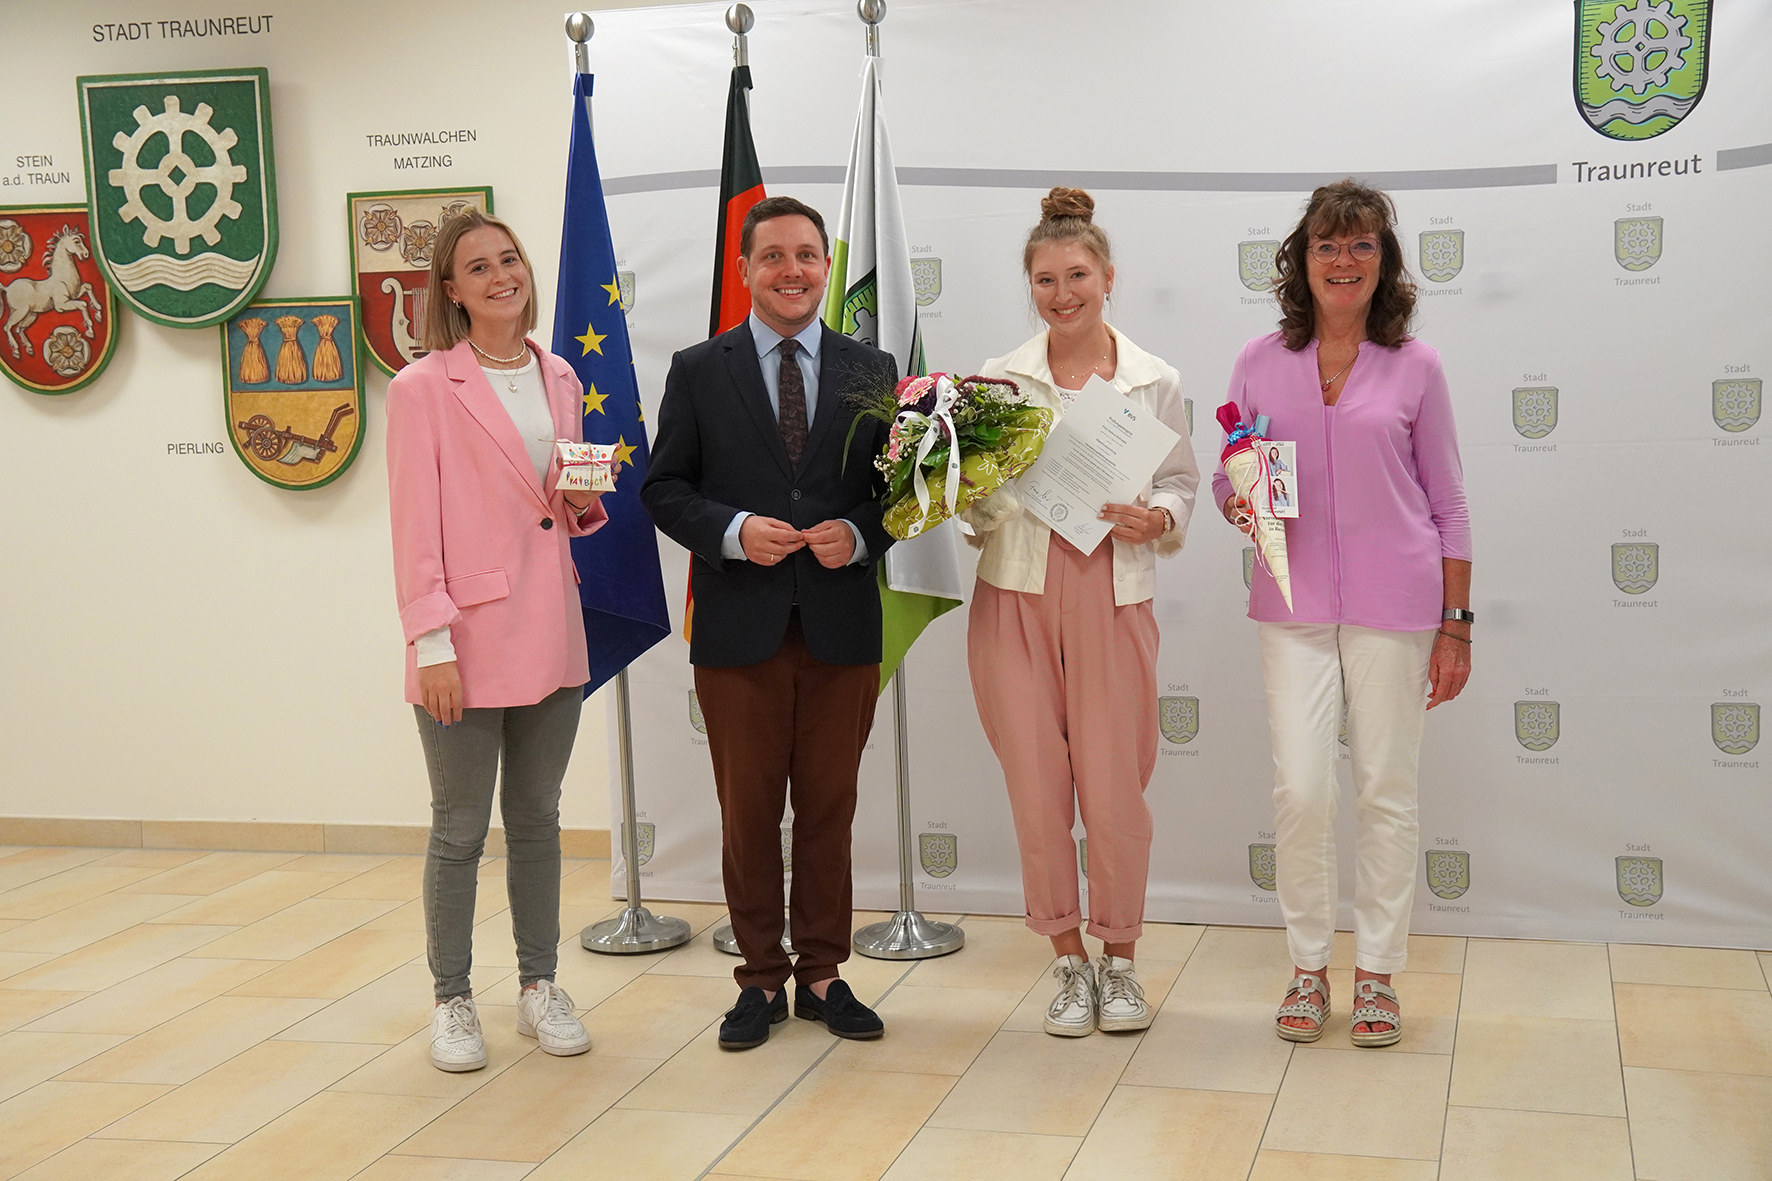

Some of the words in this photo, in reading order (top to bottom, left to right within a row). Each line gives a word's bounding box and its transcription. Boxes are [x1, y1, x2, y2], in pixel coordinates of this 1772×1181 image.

[93, 22, 152, 42] STADT
[158, 15, 273, 38] TRAUNREUT
[366, 130, 476, 147] TRAUNWALCHEN
[17, 155, 52, 168] STEIN
[394, 155, 452, 169] MATZING
[1572, 155, 1701, 182] Traunreut
[3, 174, 24, 186] a.d.
[27, 172, 69, 184] TRAUN
[1627, 202, 1651, 212] Stadt
[1430, 216, 1453, 225] Stadt
[1248, 227, 1270, 235] Stadt
[911, 245, 932, 253] Stadt
[1615, 277, 1660, 285] Traunreut
[1420, 288, 1462, 296] Traunreut
[1725, 364, 1750, 373] Stadt
[1523, 373, 1547, 381] Stadt
[1712, 438, 1759, 446] Traunreut
[168, 442, 224, 454] PIERLING
[1513, 444, 1557, 452] Traunreut
[1623, 529, 1647, 537] Stadt
[1525, 687, 1548, 695] Stadt
[1723, 689, 1748, 697] Stadt
[1160, 748, 1199, 756] Traunreut
[1516, 756, 1559, 764] Traunreut
[1712, 759, 1759, 768] Traunreut
[1258, 831, 1276, 839] Stad
[1436, 837, 1458, 845] Stadt
[1626, 843, 1650, 851] Stadt
[921, 882, 956, 891] Traunreut
[1428, 903, 1470, 912] Traunreut
[1619, 910, 1664, 920] Traunreut
